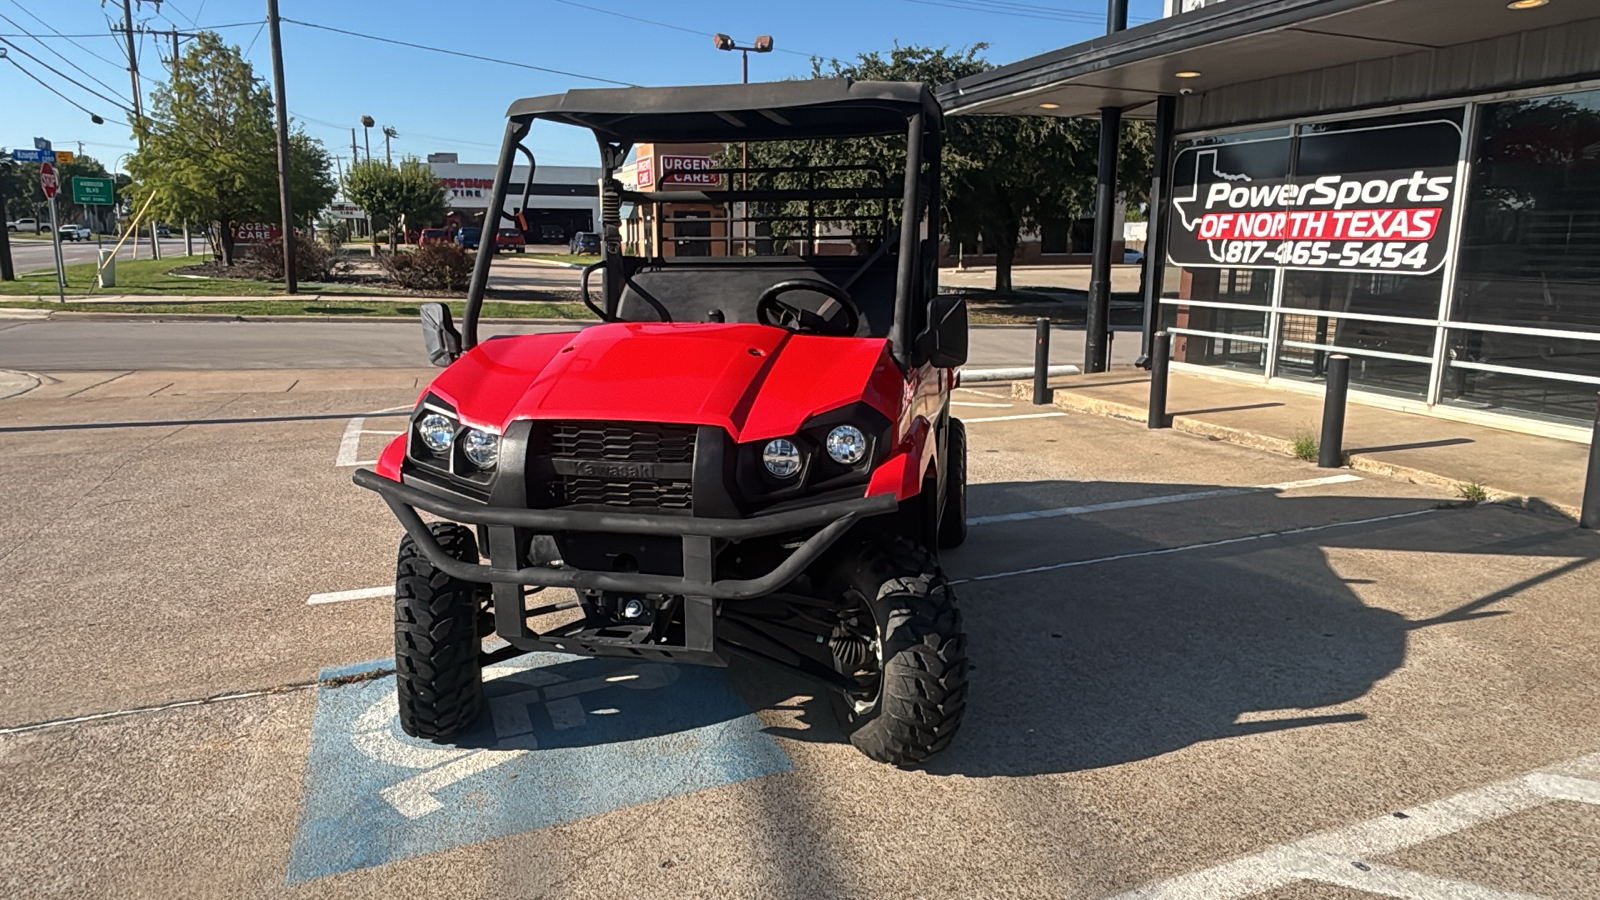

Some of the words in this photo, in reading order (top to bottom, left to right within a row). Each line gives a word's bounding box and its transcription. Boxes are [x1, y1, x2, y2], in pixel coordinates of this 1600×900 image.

[41, 173, 55, 187] STOP
[673, 174, 710, 182] CARE
[1205, 170, 1452, 210] PowerSports
[1200, 214, 1230, 237] OF
[1234, 212, 1328, 238] NORTH
[1333, 210, 1432, 238] TEXAS
[238, 231, 271, 239] CARE
[1226, 240, 1429, 269] 817-465-5454
[576, 462, 655, 478] Kawasaki
